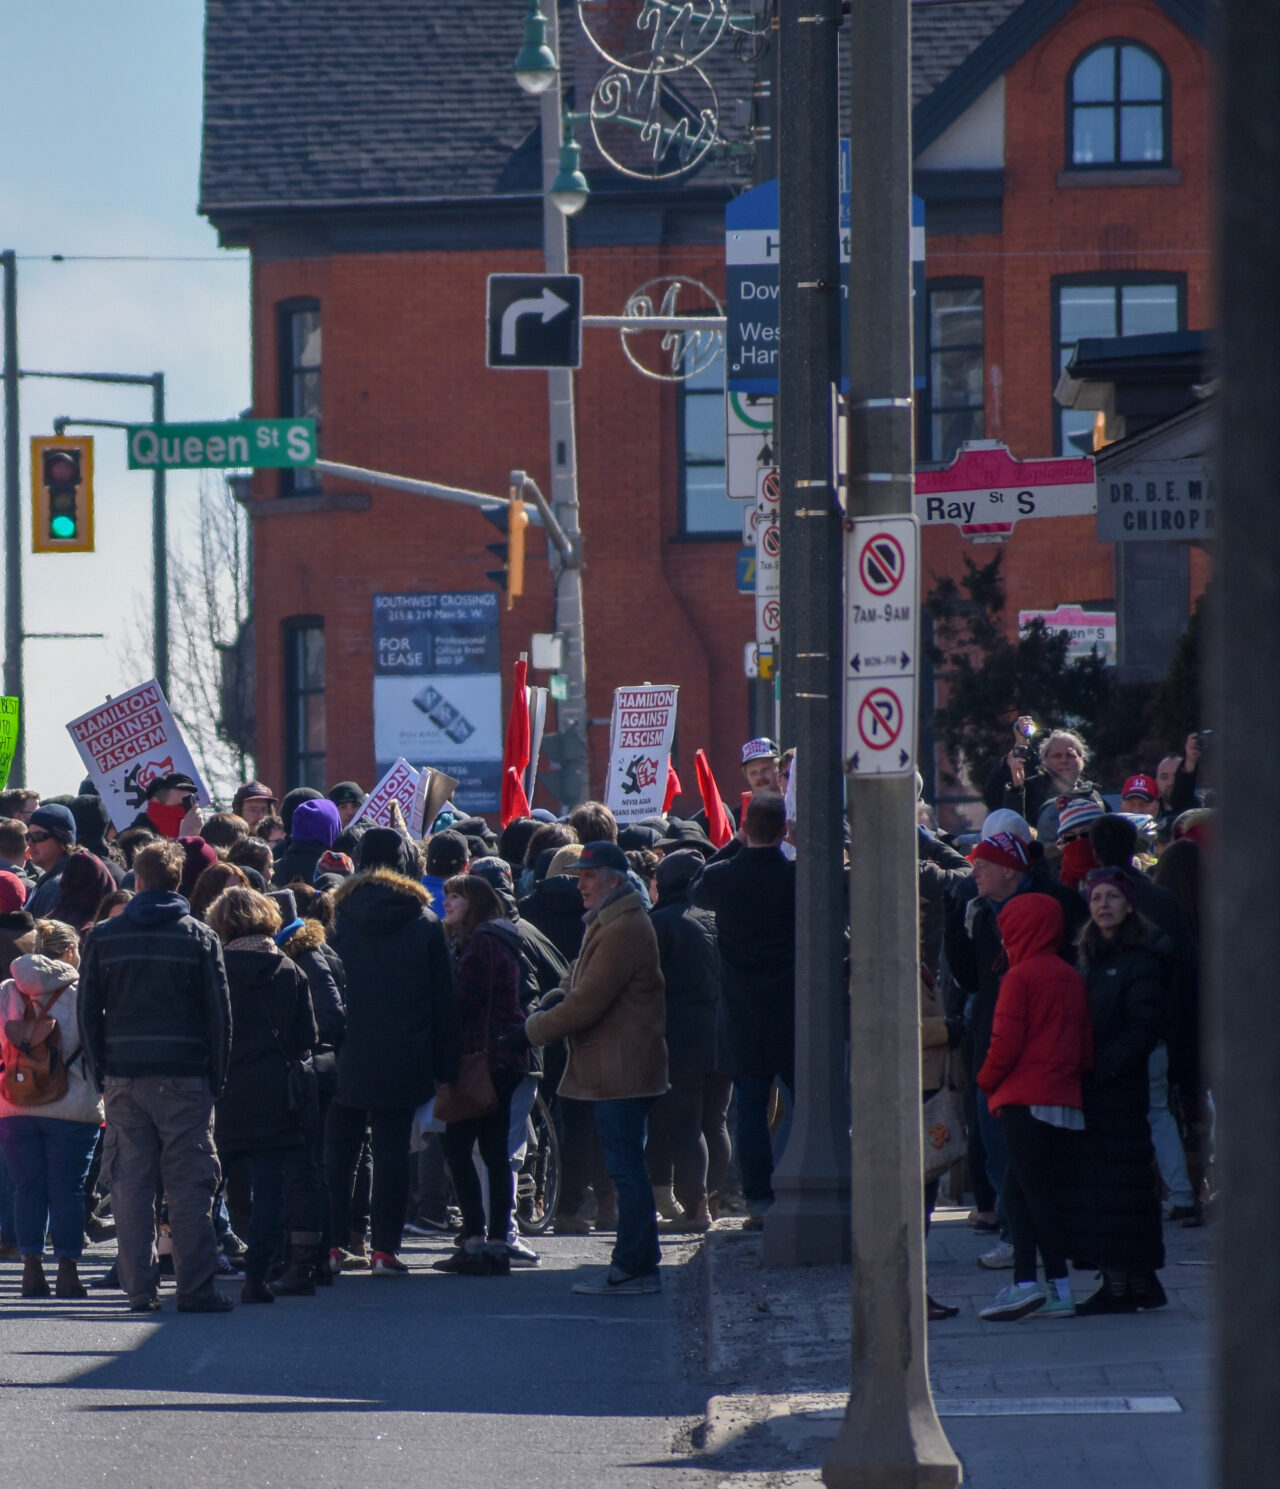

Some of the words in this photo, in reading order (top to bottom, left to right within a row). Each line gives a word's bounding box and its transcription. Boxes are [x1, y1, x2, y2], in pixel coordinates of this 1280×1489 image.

[131, 430, 249, 464] Queen
[256, 425, 280, 449] St
[286, 425, 311, 461] S
[1110, 482, 1139, 503] DR.
[926, 497, 976, 523] Ray
[989, 491, 1004, 503] St
[1016, 490, 1036, 514] S
[375, 595, 439, 609] SOUTHWEST
[440, 593, 496, 607] CROSSINGS
[388, 609, 405, 621] 215
[434, 608, 456, 619] Main
[435, 635, 486, 646] Professional
[1096, 627, 1105, 640] S
[379, 637, 410, 651] FOR
[379, 652, 423, 667] LEASE
[1, 699, 18, 715] BEST
[620, 691, 674, 708] HAMILTON
[73, 686, 159, 740] HAMILTON
[621, 711, 668, 727] AGAINST
[1, 719, 11, 736] TO
[91, 708, 161, 755] AGAINST
[621, 730, 663, 747] FASCISM
[96, 728, 167, 773] FASCISM
[361, 765, 409, 820] MILTON
